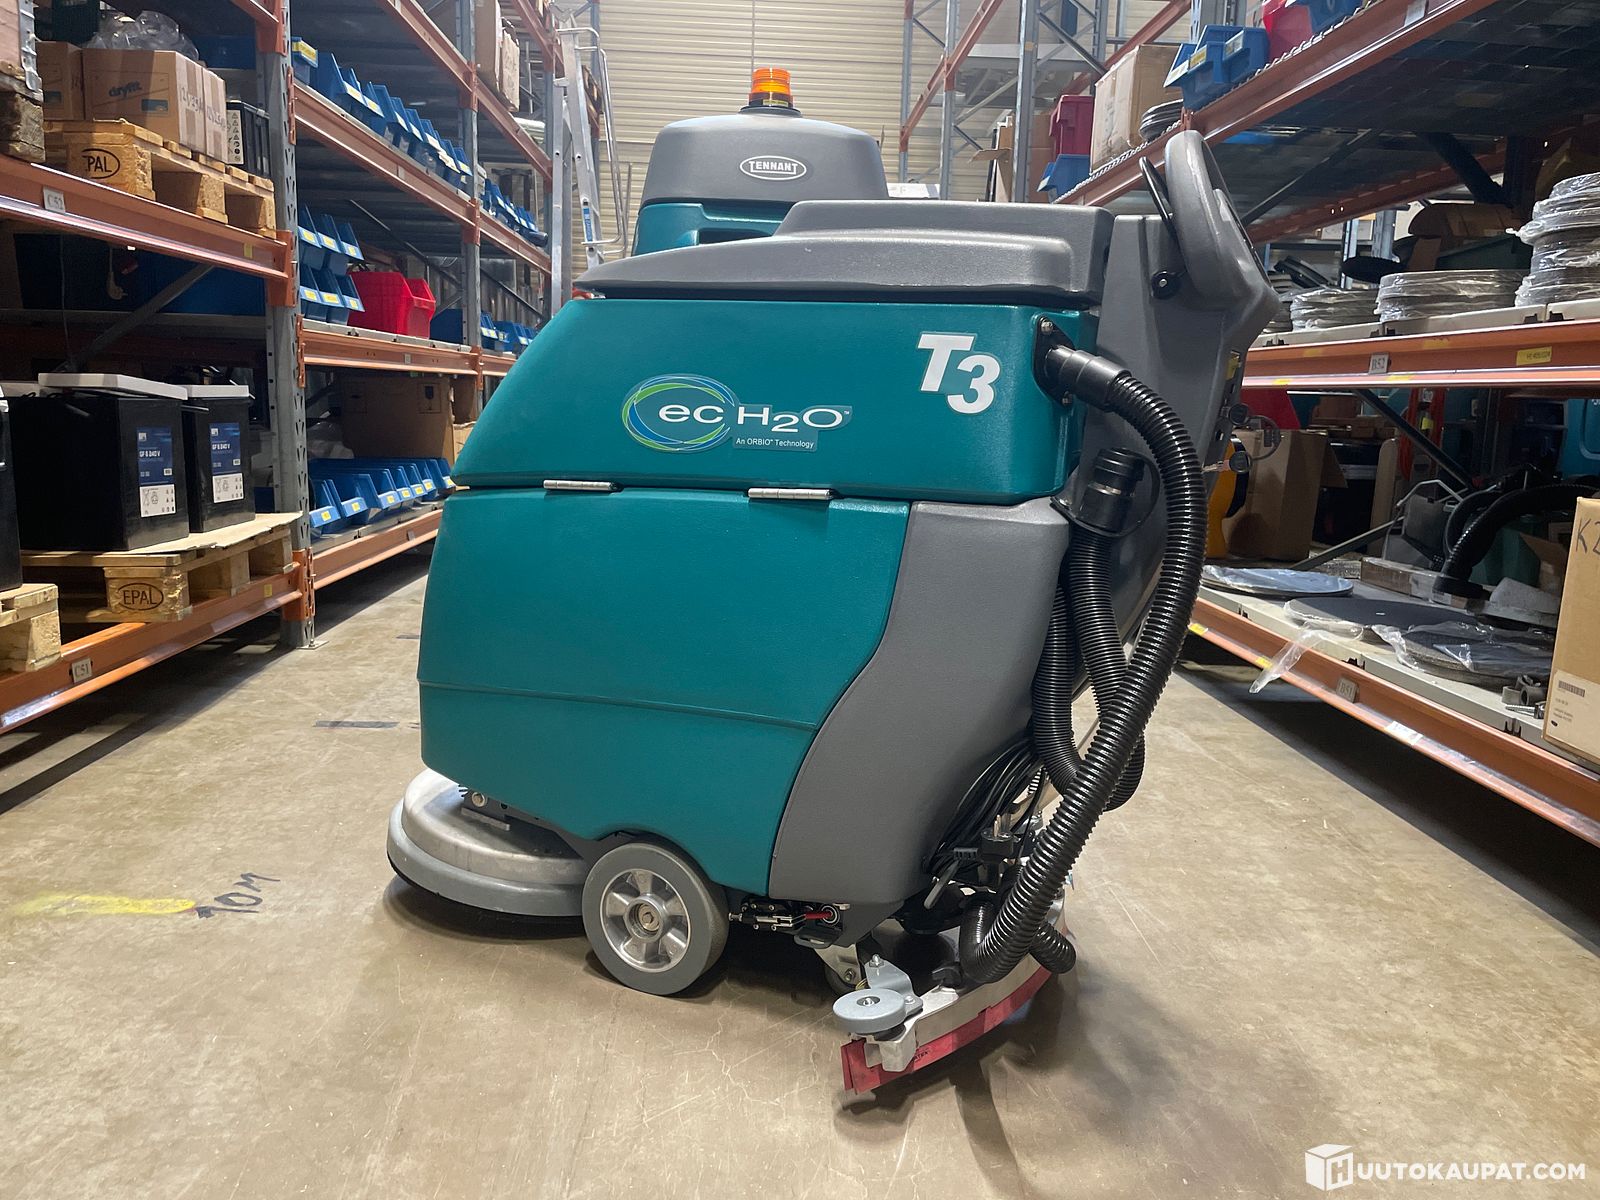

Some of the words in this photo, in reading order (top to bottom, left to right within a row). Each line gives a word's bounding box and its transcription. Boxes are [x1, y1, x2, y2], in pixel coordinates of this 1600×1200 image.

[82, 156, 112, 172] PAL
[749, 161, 798, 175] TENNANT
[918, 334, 1000, 414] T3
[775, 439, 814, 449] Technology
[123, 585, 157, 605] EPAL
[74, 663, 90, 676] C51
